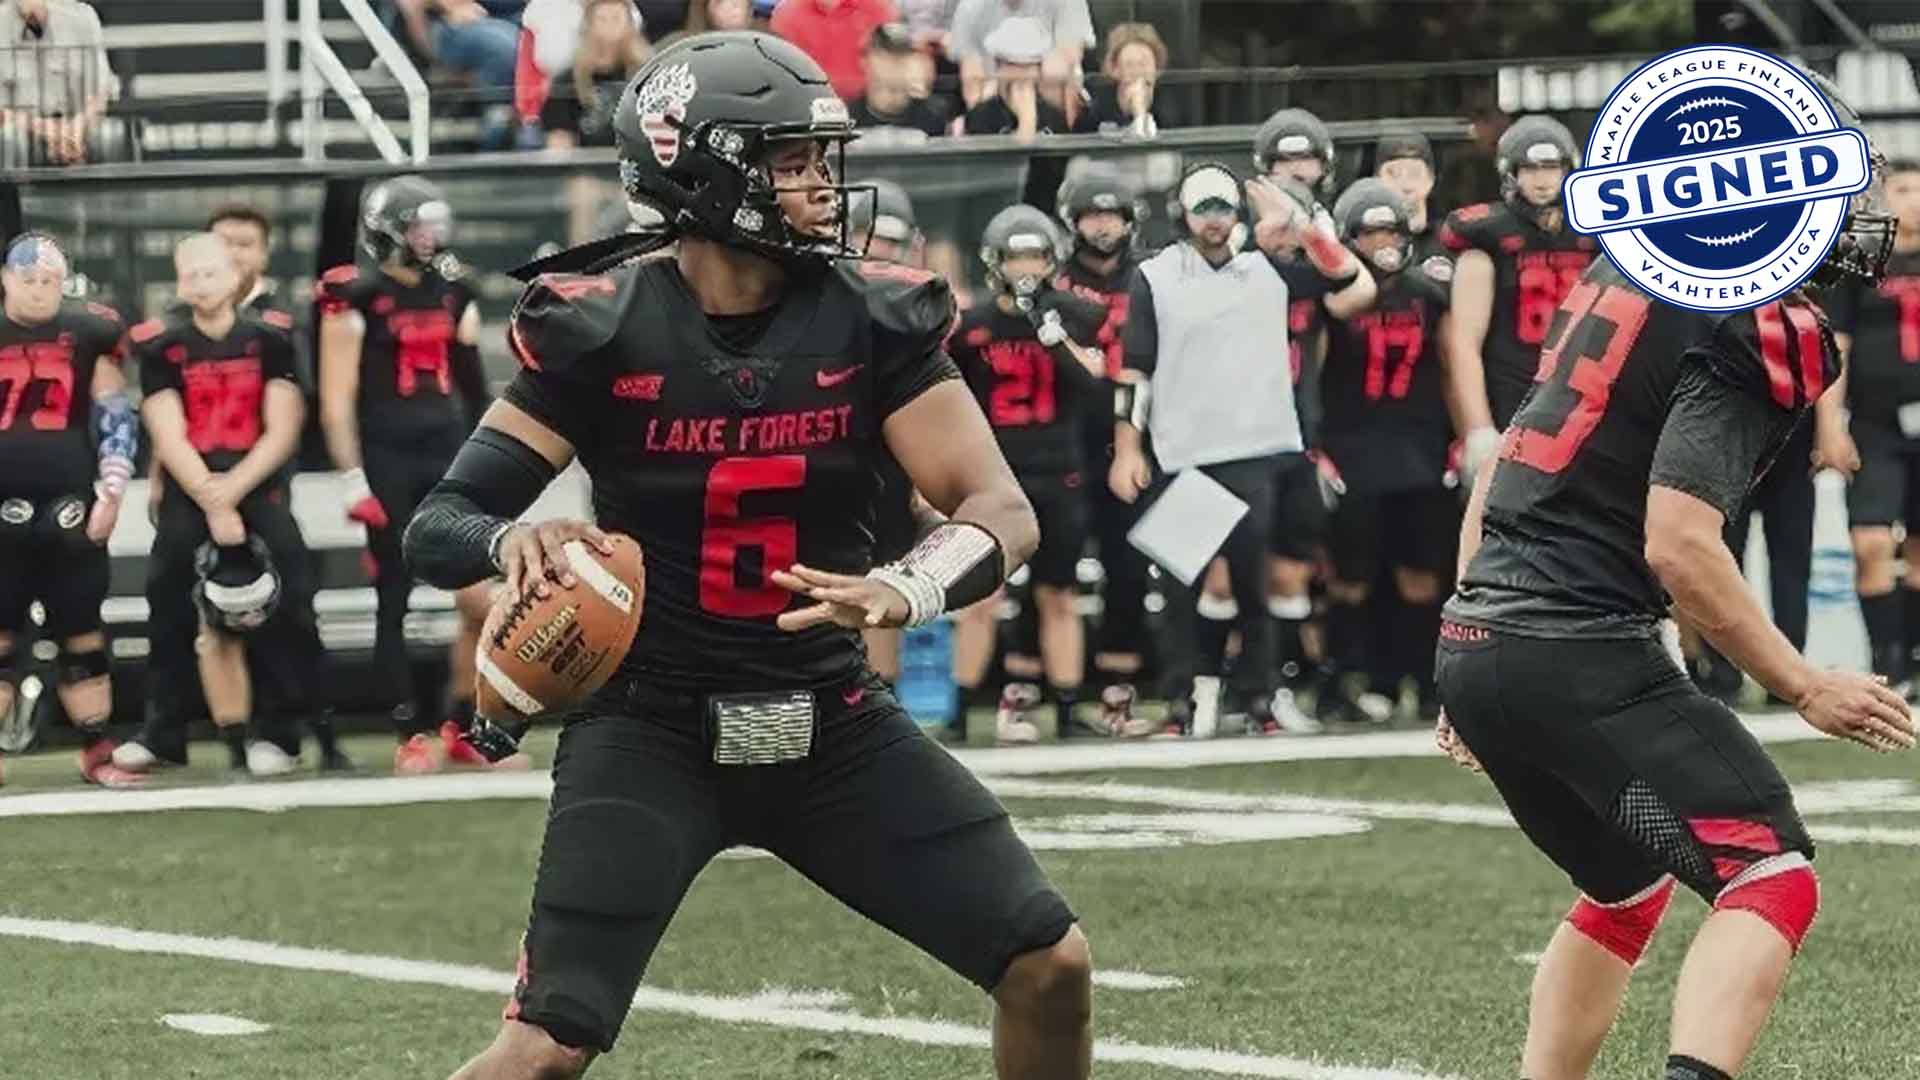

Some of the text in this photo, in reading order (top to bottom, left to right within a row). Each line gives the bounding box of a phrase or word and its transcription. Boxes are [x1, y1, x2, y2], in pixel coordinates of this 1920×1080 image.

[990, 350, 1057, 427] 21
[1364, 325, 1423, 399] 17
[645, 403, 853, 452] LAKE FOREST
[700, 454, 806, 618] 6
[516, 604, 577, 664] Wilson
